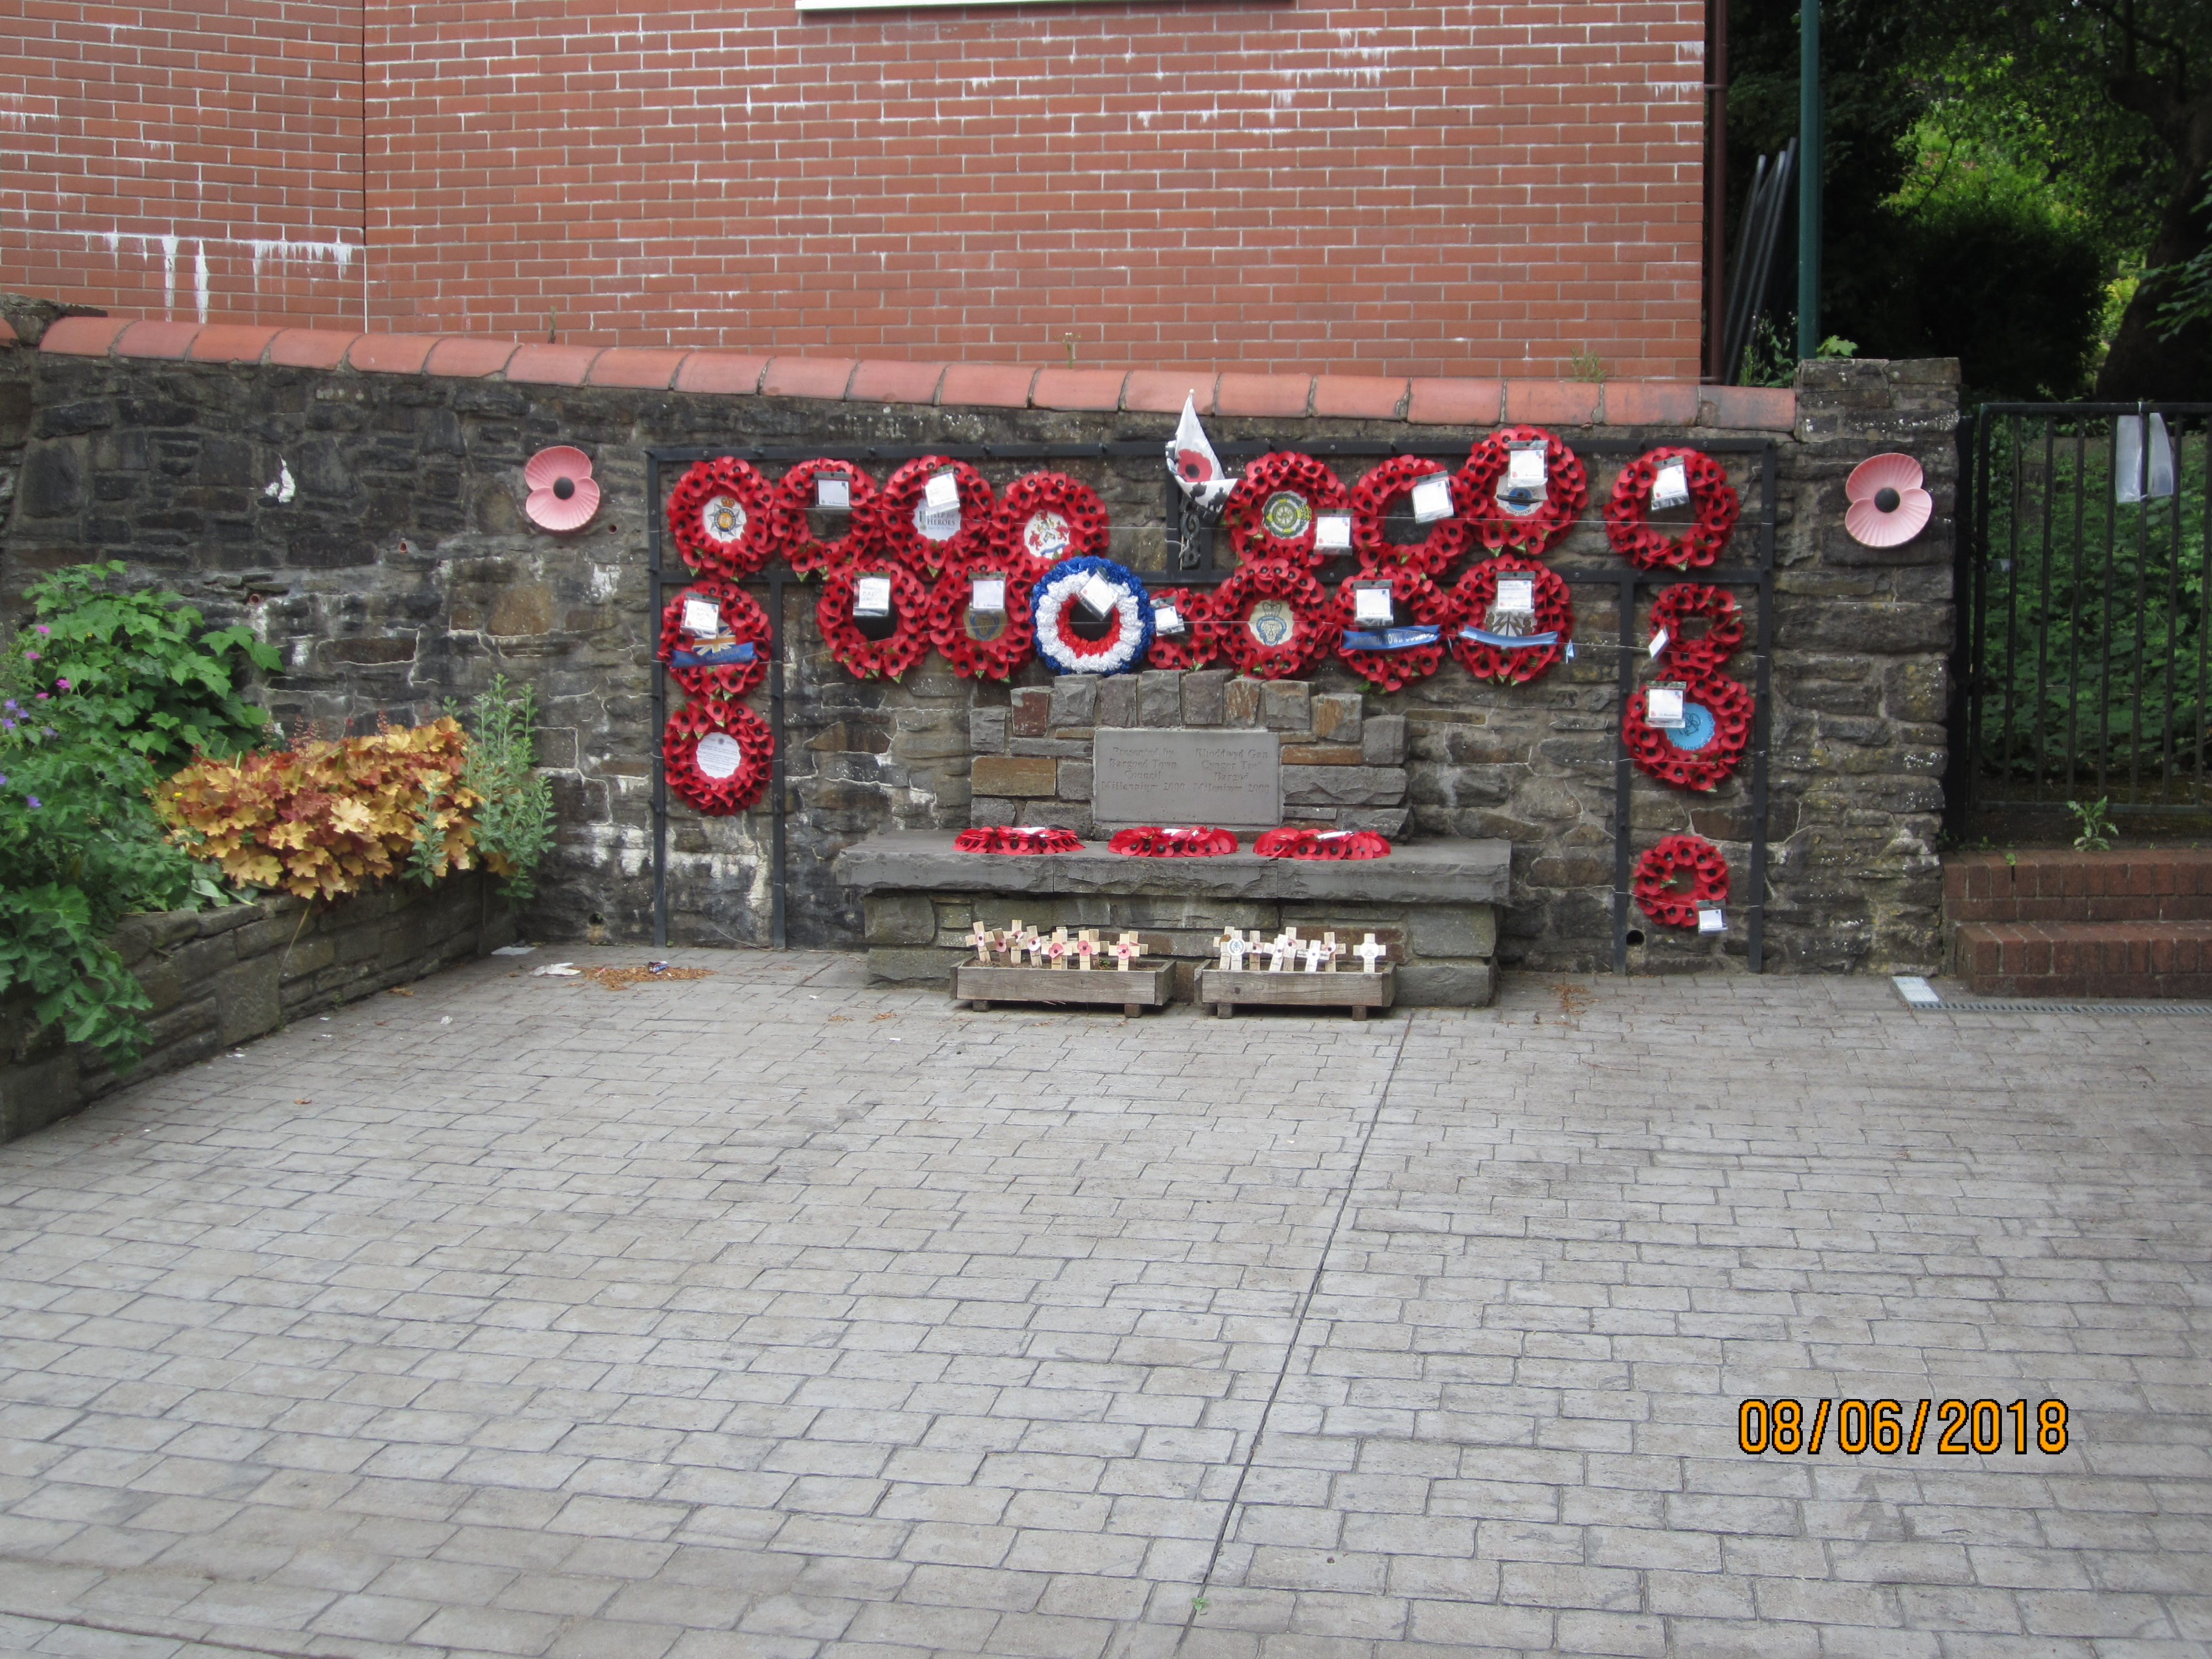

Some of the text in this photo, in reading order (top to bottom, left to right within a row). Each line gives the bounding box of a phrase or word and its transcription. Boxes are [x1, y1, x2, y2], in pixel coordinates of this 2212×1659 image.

[1113, 747, 1159, 757] Presented
[1248, 749, 1268, 758] Gan
[1109, 758, 1177, 769] Bargoed Town
[1125, 770, 1161, 780] Council
[1163, 782, 1185, 791] 2000
[1248, 784, 1270, 793] 2000
